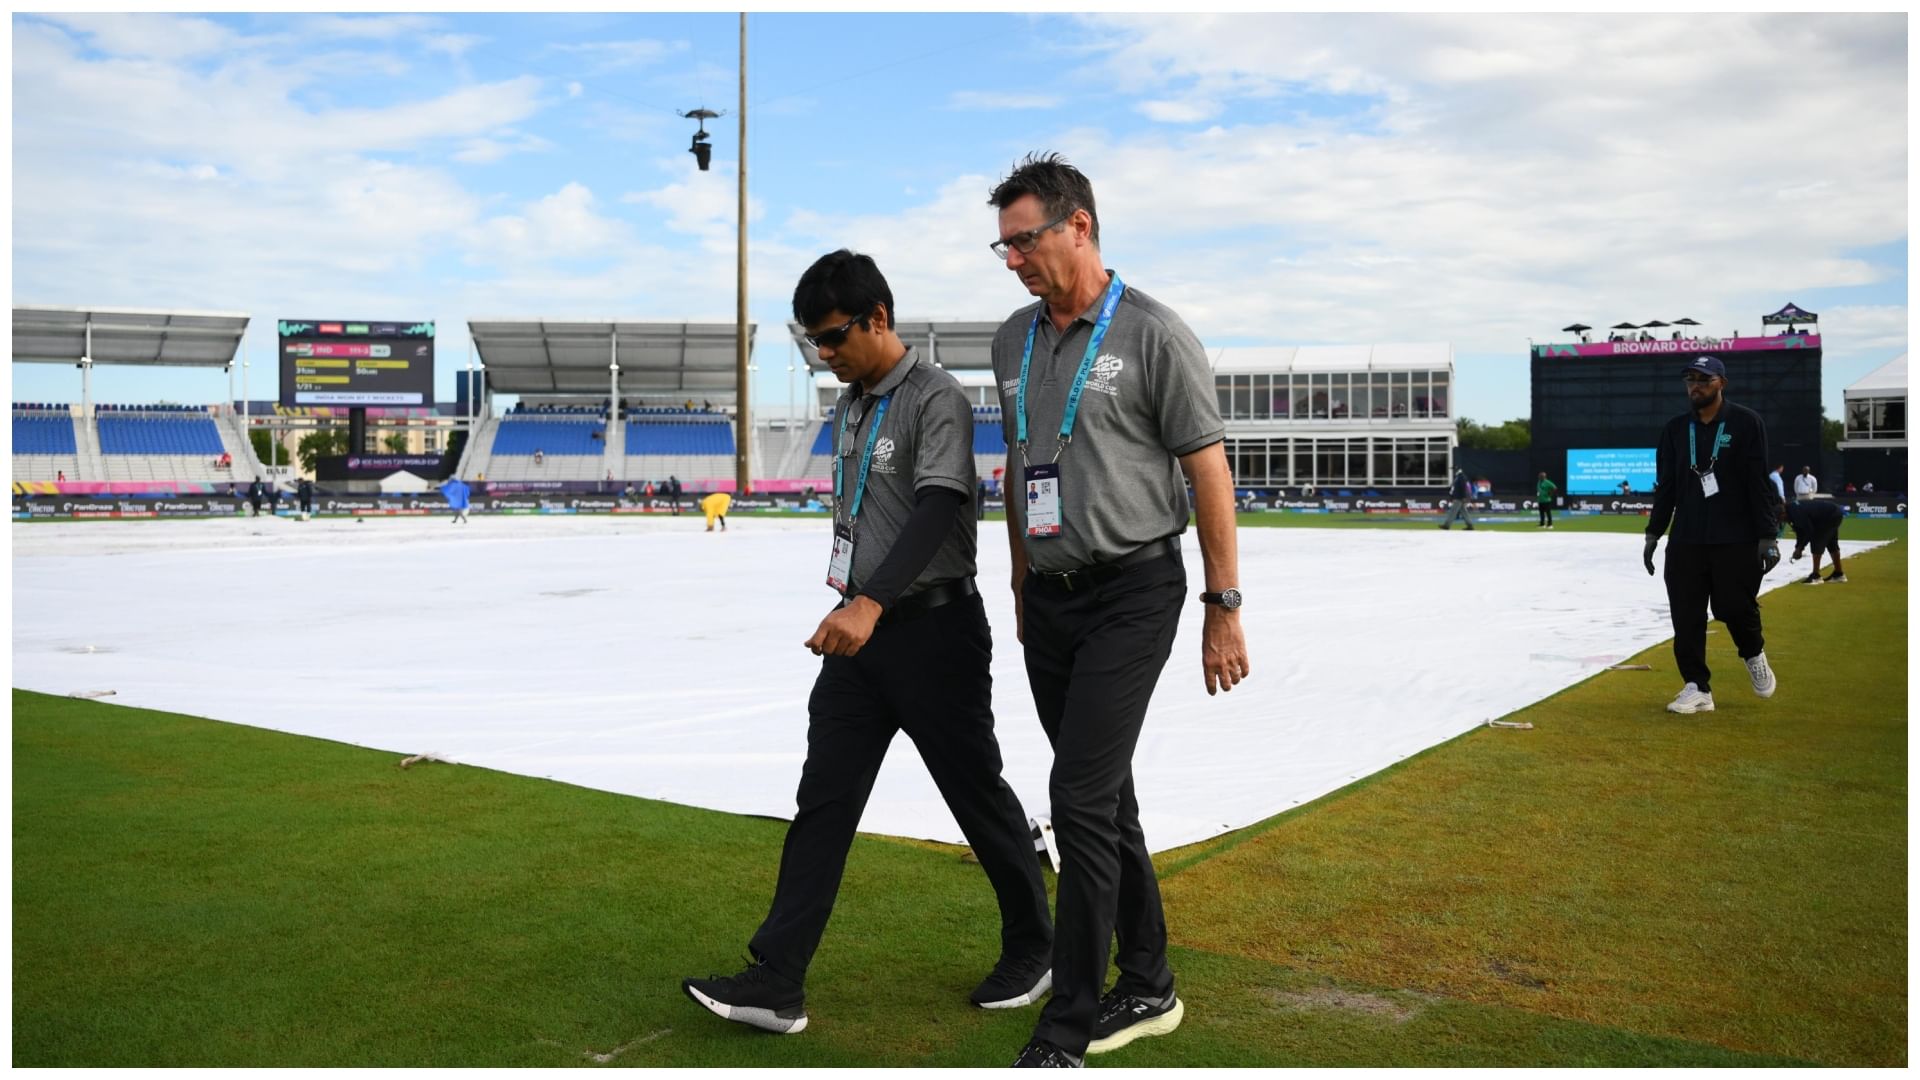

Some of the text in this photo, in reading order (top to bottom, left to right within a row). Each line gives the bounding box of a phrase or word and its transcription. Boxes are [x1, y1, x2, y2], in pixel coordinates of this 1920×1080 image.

[1613, 341, 1677, 354] BROWARD
[1068, 358, 1091, 409] FIELD OF PLAY
[266, 467, 288, 476] BAR
